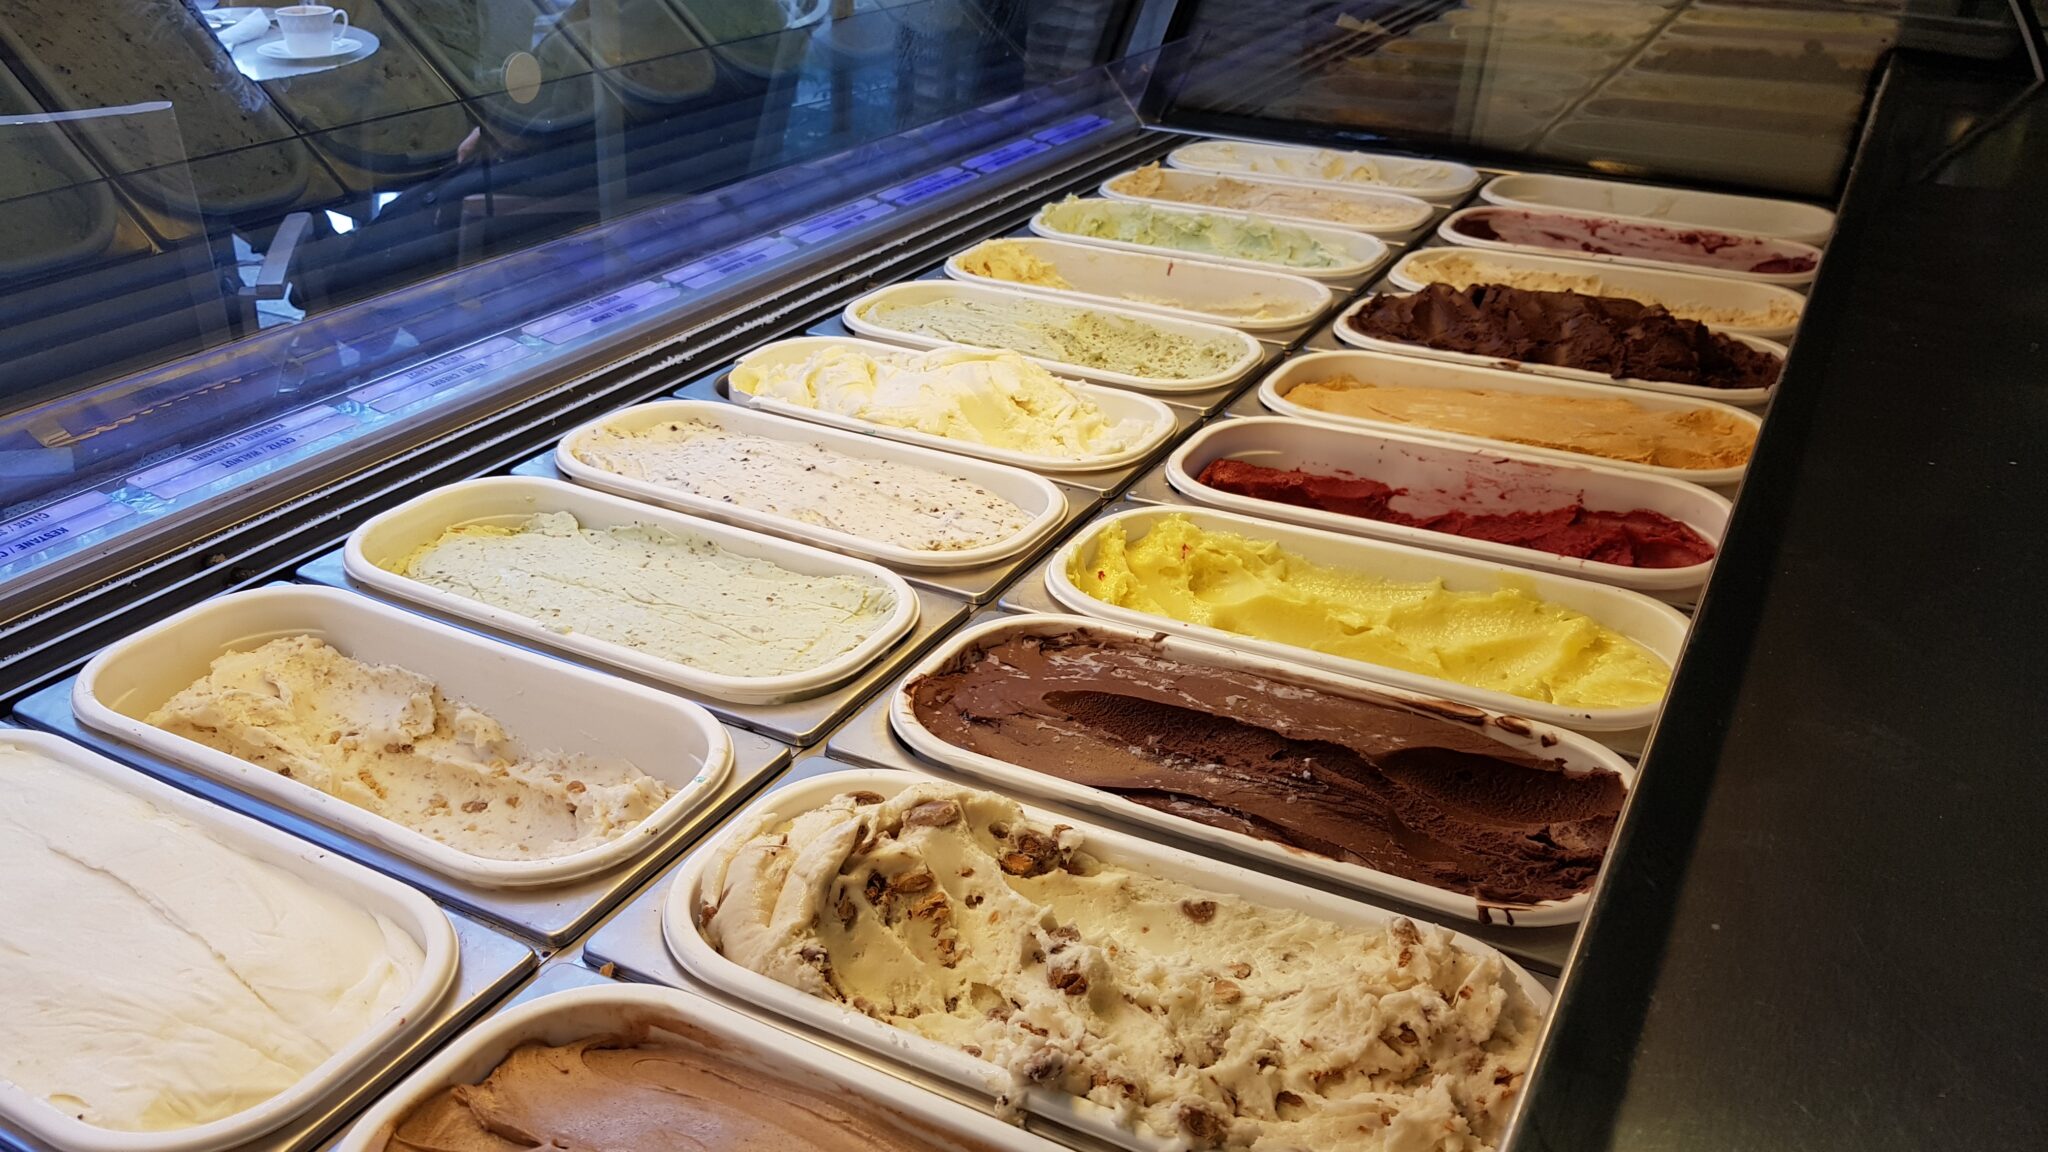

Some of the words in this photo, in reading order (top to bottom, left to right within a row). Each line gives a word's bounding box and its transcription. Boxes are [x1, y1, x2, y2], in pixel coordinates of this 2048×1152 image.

[239, 423, 286, 442] KARAMEL
[187, 442, 236, 461] CARAMEL
[221, 450, 262, 468] WALNUT
[15, 527, 69, 551] KESTANE
